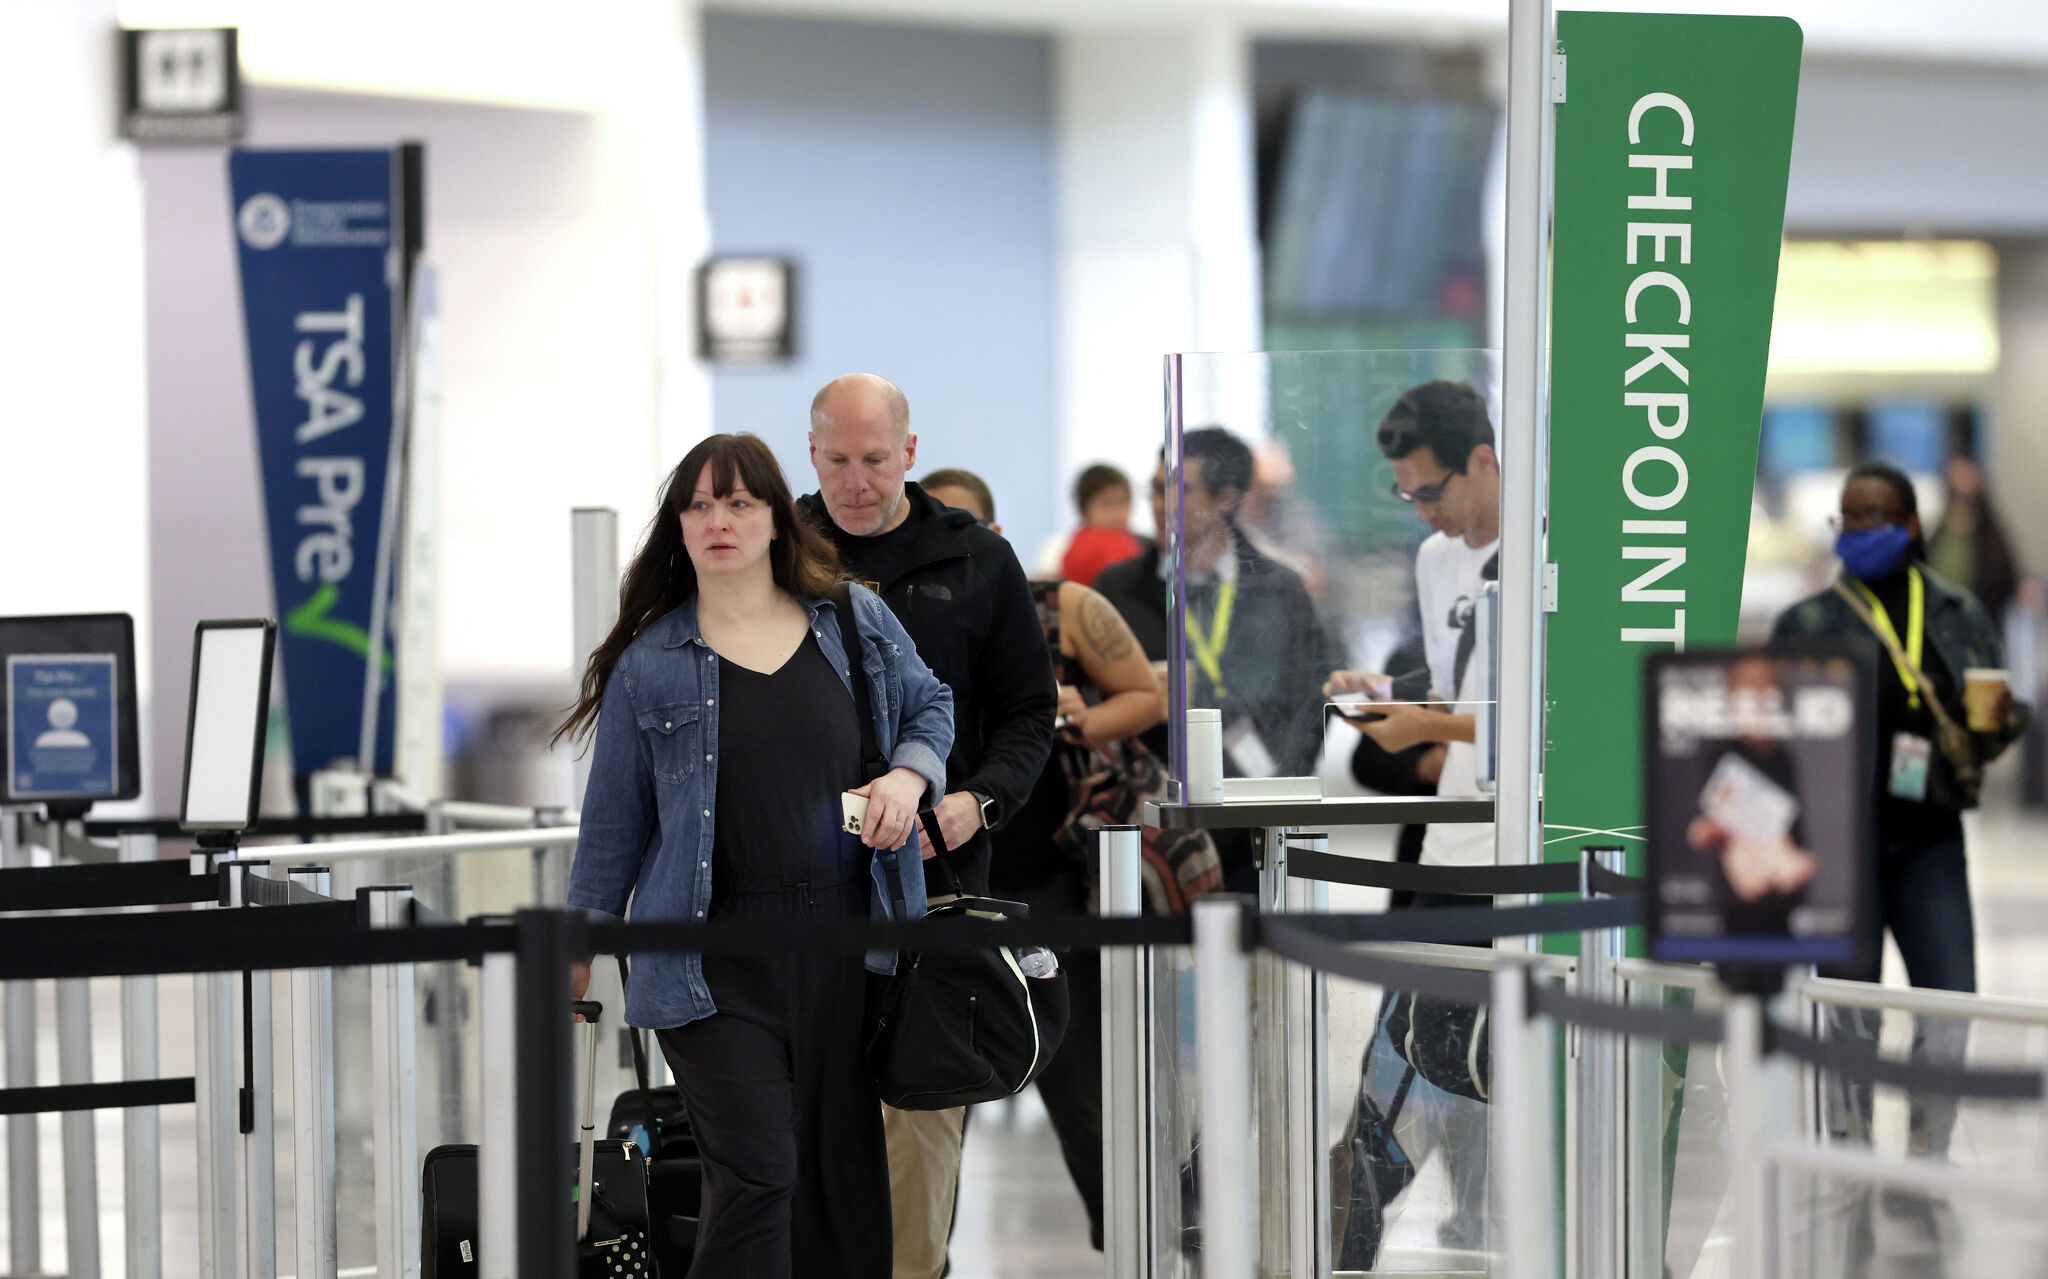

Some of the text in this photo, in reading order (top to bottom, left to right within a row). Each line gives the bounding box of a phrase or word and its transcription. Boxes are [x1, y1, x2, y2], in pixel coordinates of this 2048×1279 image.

[294, 293, 365, 444] TSA
[1620, 91, 1695, 655] CHECKPOINT
[294, 457, 366, 583] Pre
